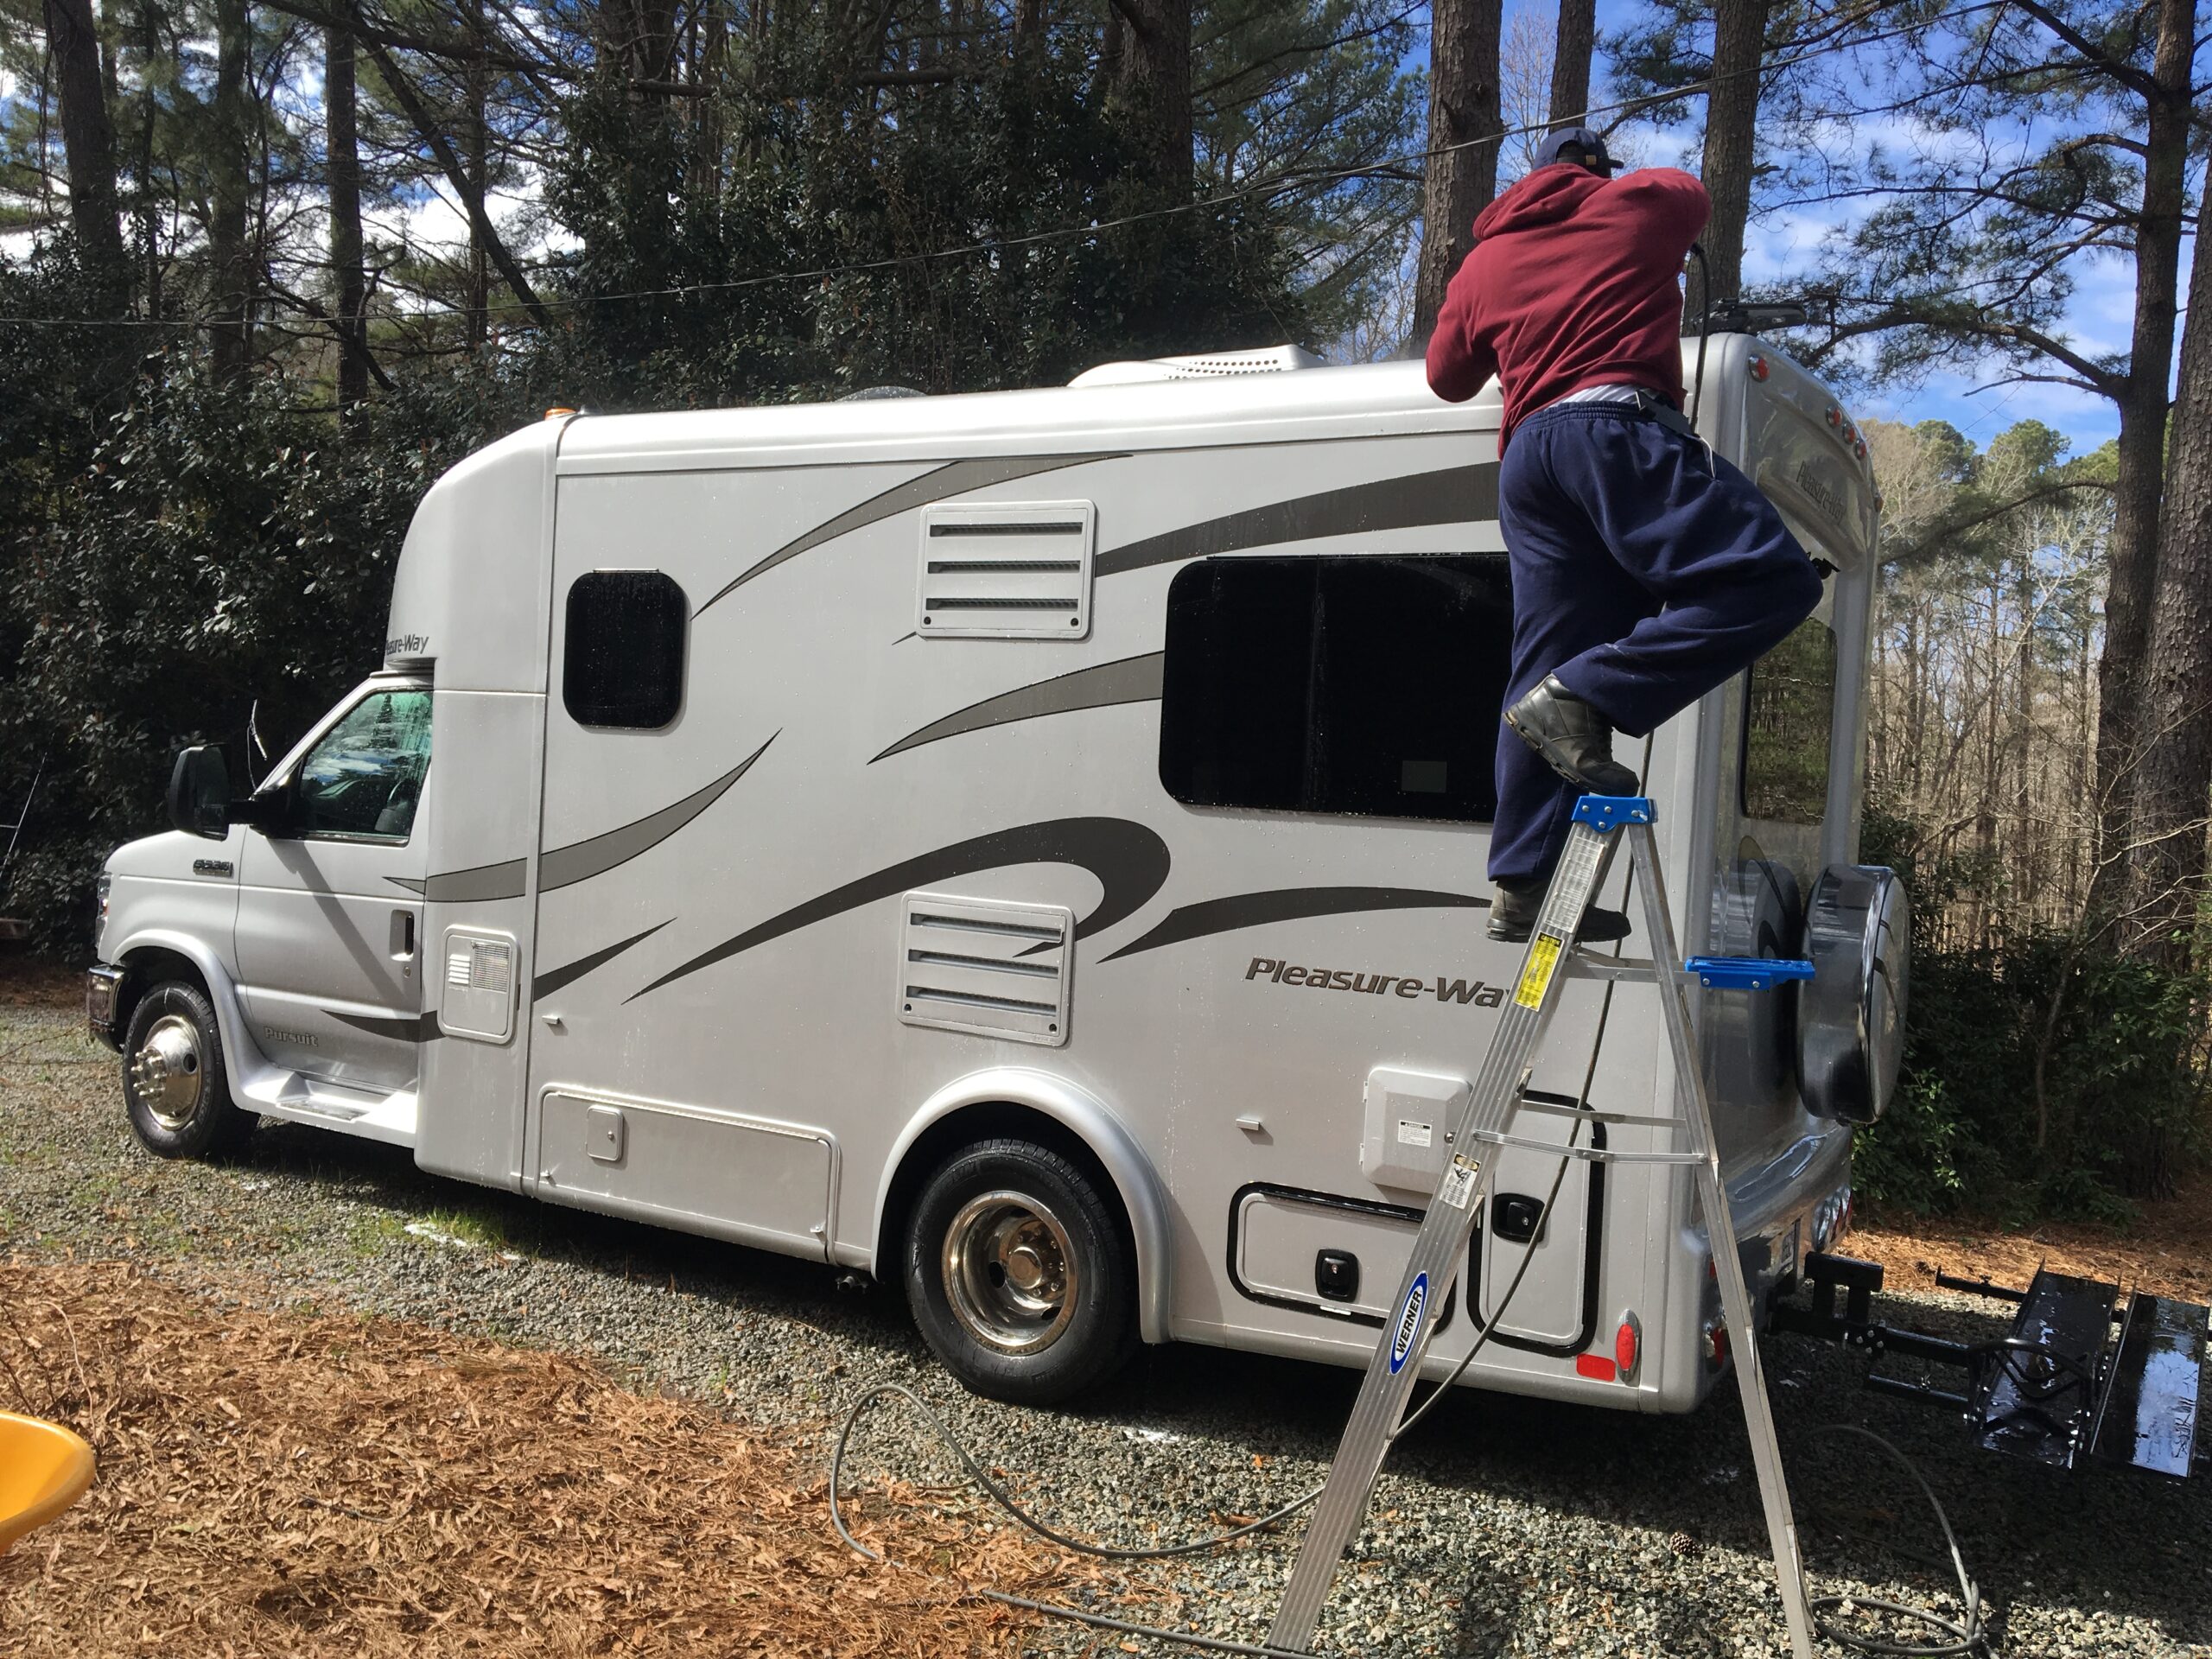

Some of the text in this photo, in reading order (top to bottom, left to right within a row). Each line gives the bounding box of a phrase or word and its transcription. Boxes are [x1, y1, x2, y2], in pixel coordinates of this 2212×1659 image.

[1245, 957, 1510, 1008] Pleasure-Wa
[264, 1027, 319, 1047] Pursuit
[1395, 1290, 1422, 1354] WERNER
